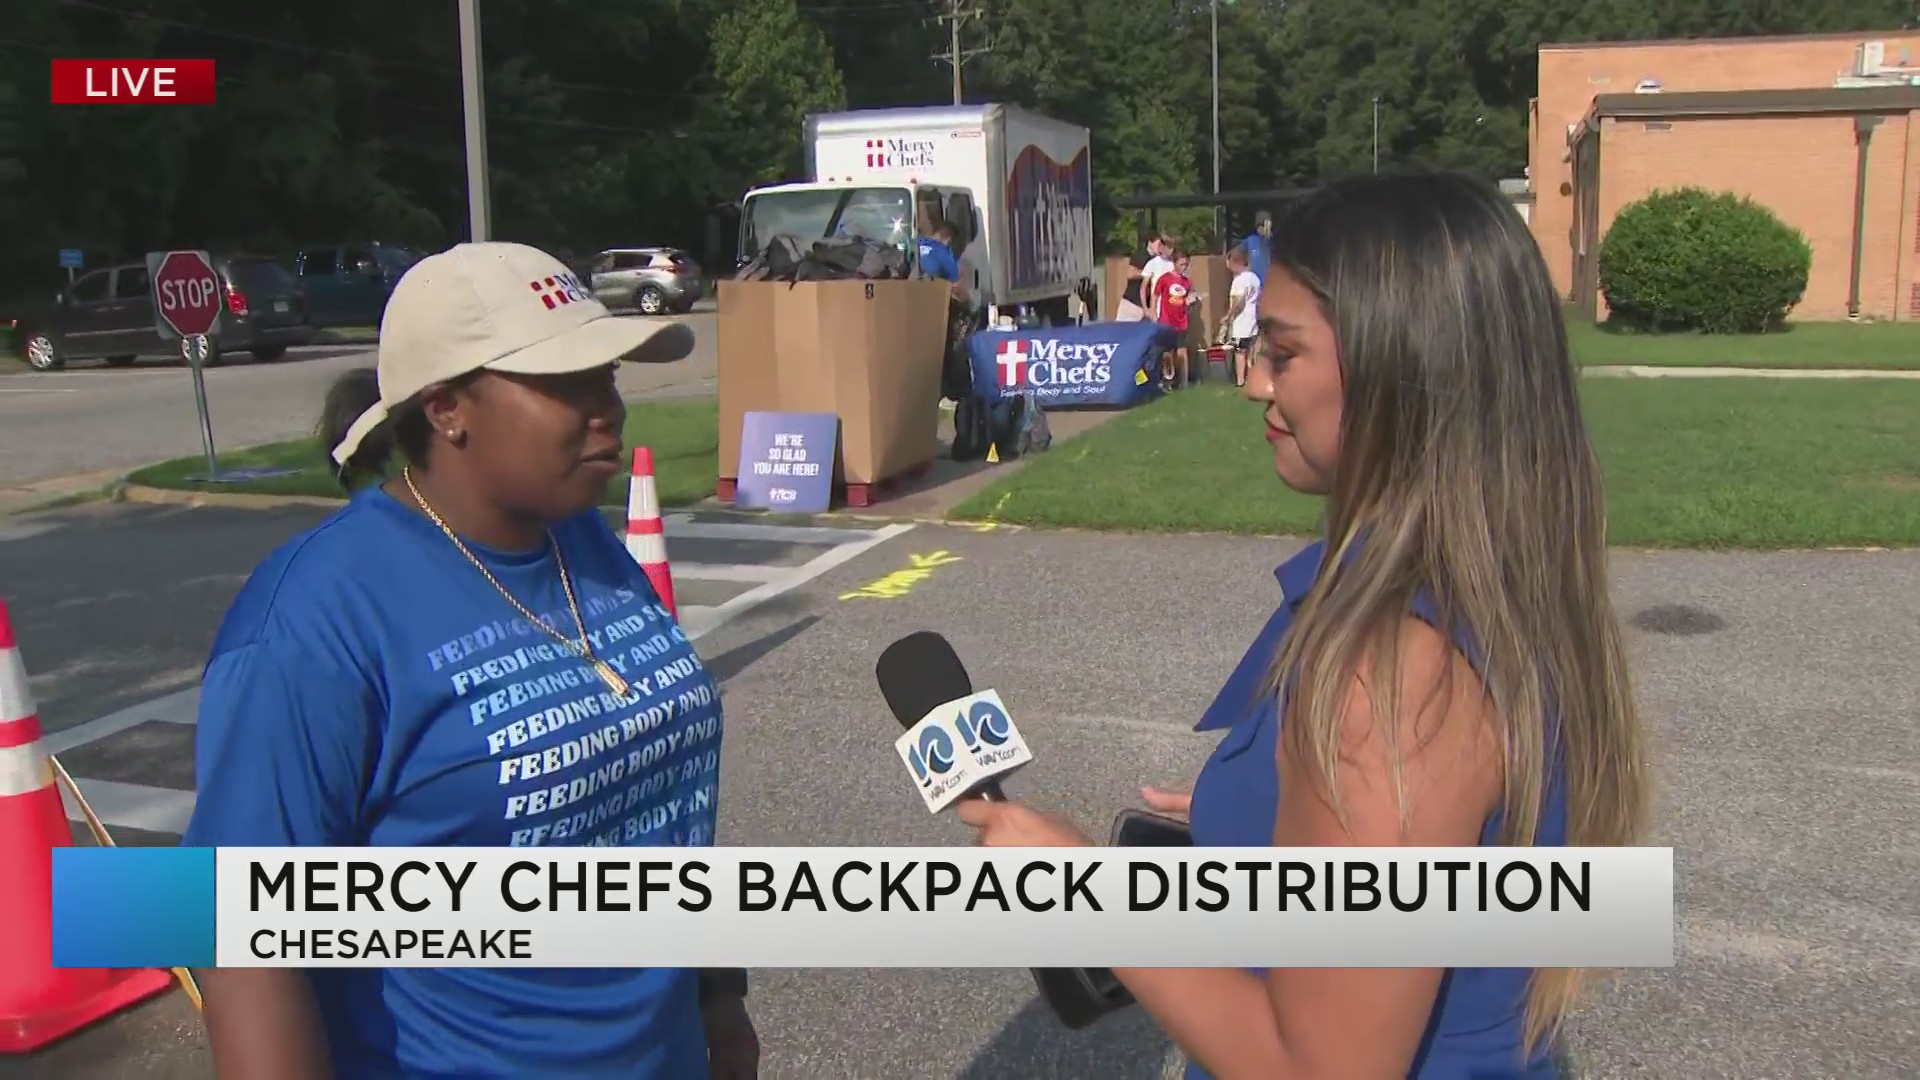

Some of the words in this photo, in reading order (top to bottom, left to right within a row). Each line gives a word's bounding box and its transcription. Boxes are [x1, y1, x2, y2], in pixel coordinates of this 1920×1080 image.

[887, 153, 934, 167] Chefs
[888, 138, 935, 155] Mercy
[162, 277, 214, 310] STOP
[1029, 339, 1120, 364] Mercy
[1028, 359, 1111, 386] Chefs
[753, 462, 772, 475] YOU
[772, 463, 792, 476] ARE
[792, 463, 820, 477] HERE!
[768, 447, 781, 460] SO
[782, 449, 807, 461] GLAD
[450, 643, 556, 696] FEEDING
[605, 614, 646, 644] AND
[468, 668, 580, 726] FEEDING
[630, 634, 671, 666] AND
[487, 694, 601, 756] FEEDING
[653, 656, 694, 690] AND
[498, 726, 620, 786] FEEDING
[620, 700, 675, 735] BODY
[678, 684, 713, 717] AND
[504, 758, 625, 820] FEEDING
[627, 730, 682, 776] BODY
[682, 715, 717, 749] AND
[510, 793, 625, 847] FEEDING
[624, 765, 681, 811] BODY
[680, 750, 717, 783] AND
[624, 798, 682, 841] BODY
